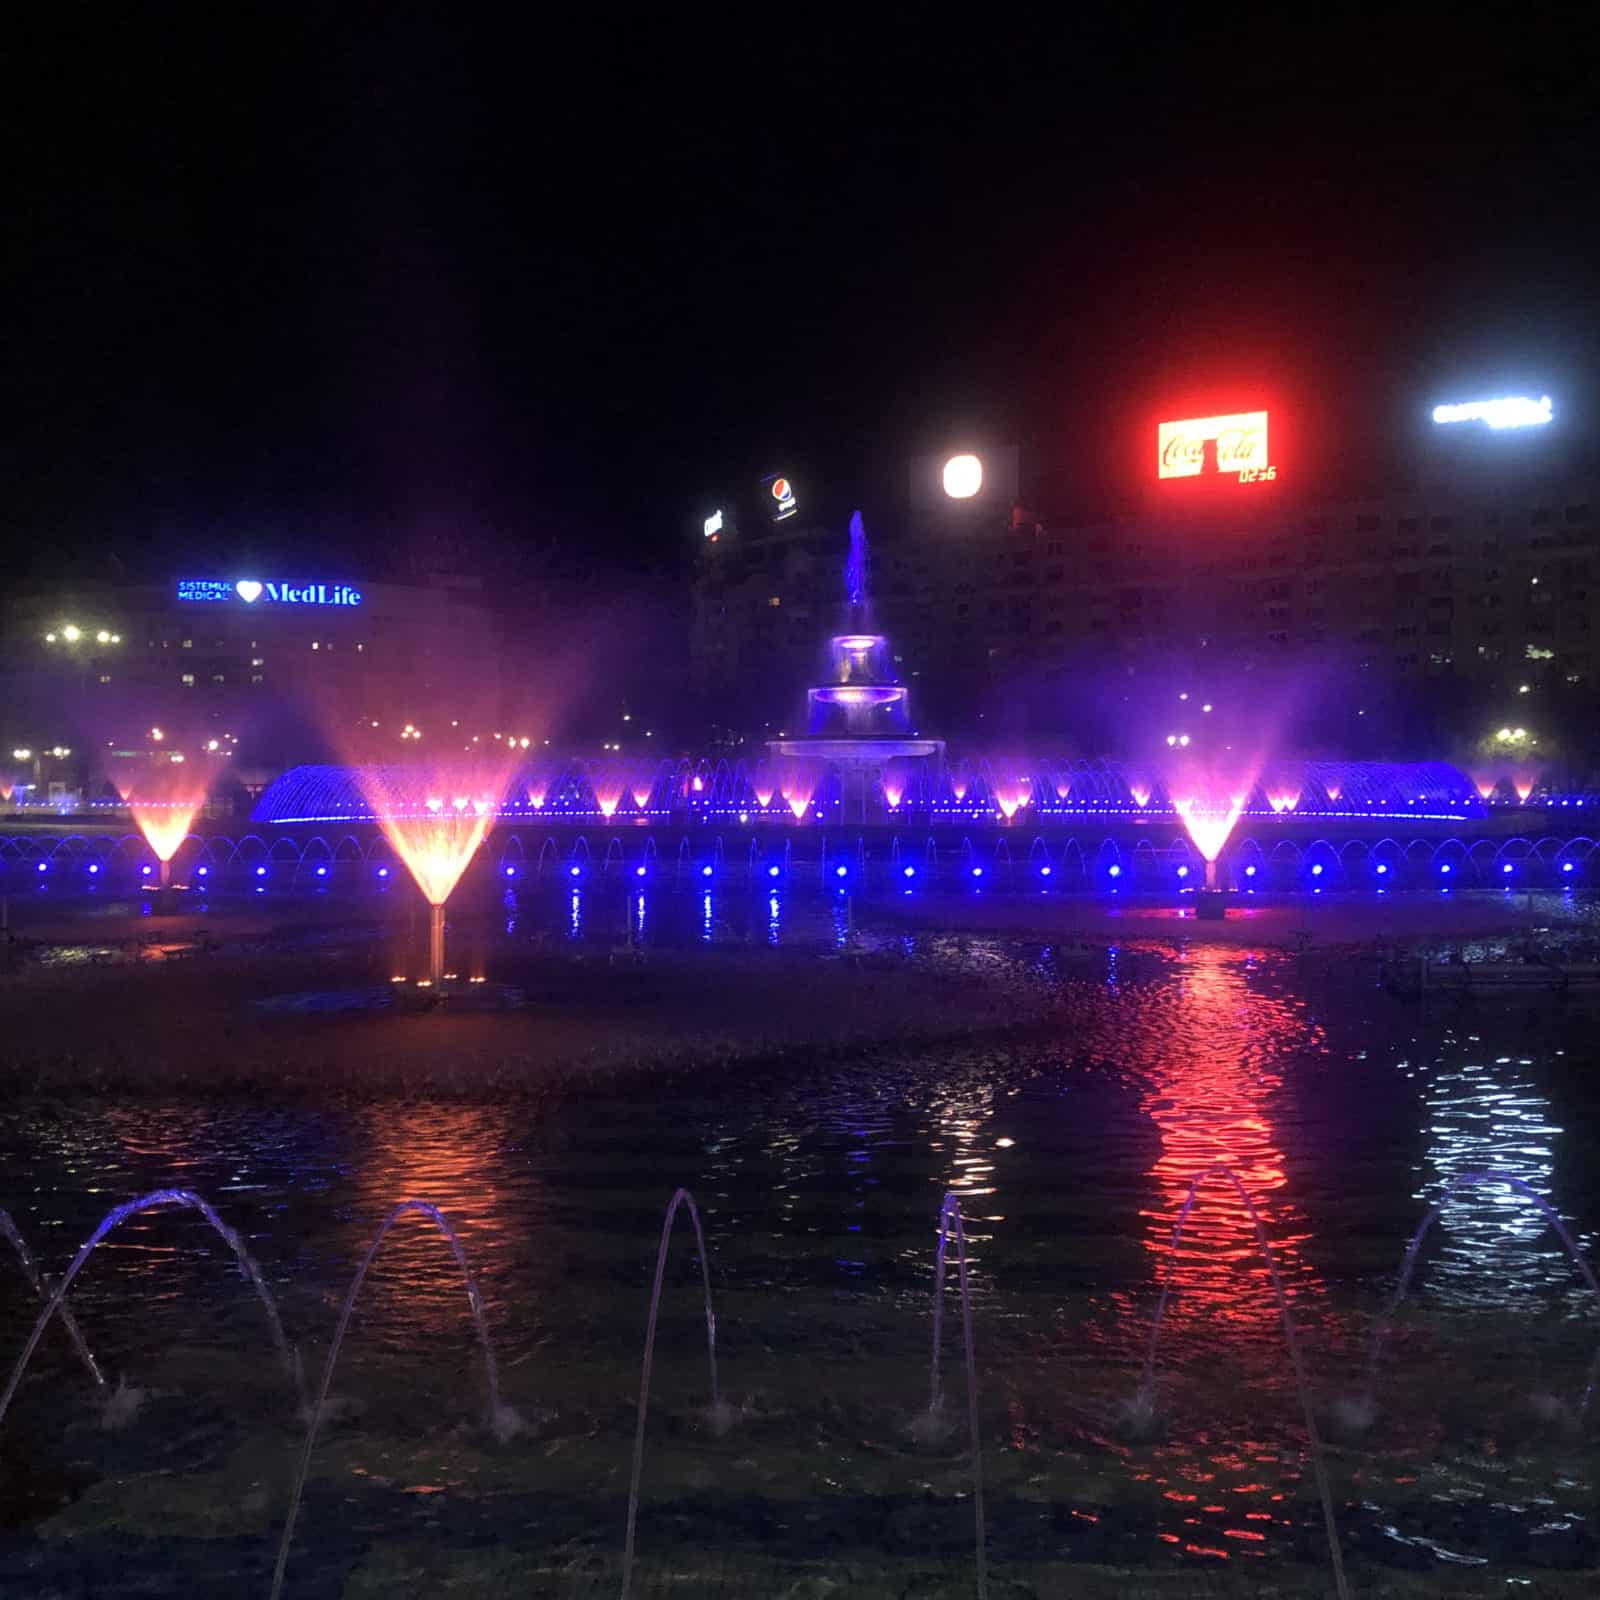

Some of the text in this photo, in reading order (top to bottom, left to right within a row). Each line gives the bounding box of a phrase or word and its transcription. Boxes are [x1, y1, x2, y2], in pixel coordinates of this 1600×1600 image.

[178, 581, 232, 591] SISTEMUL
[178, 591, 230, 601] MEDICAL
[265, 582, 361, 606] MedLife
